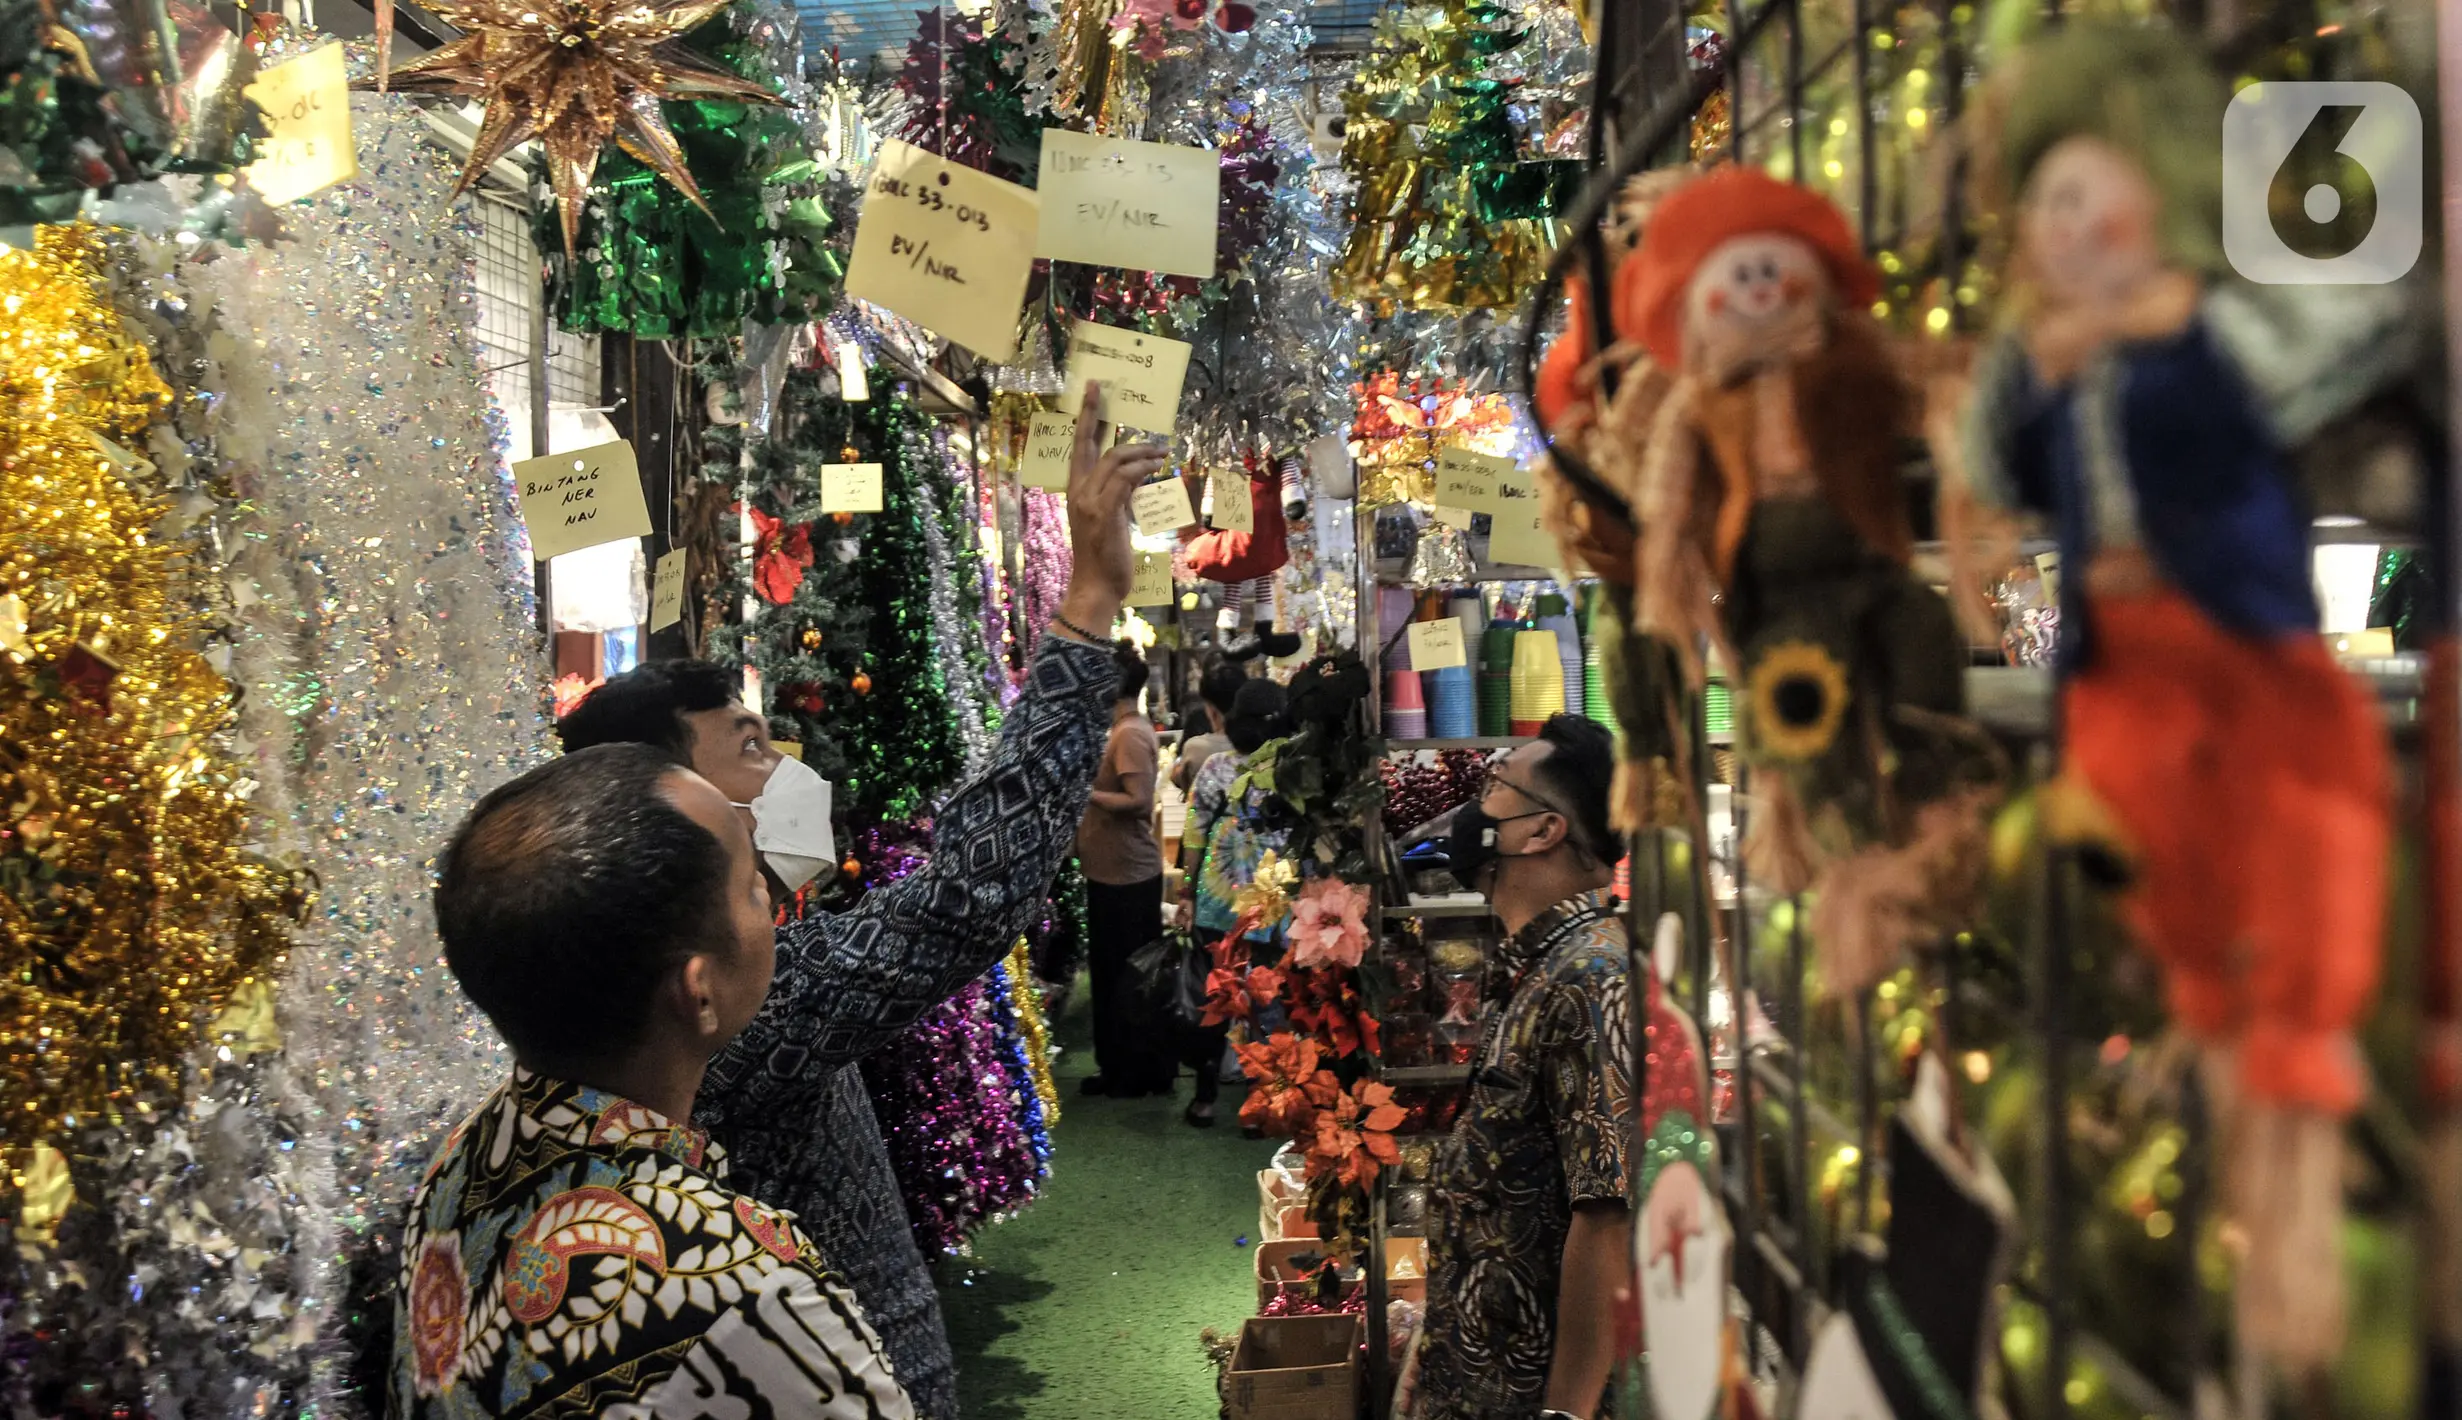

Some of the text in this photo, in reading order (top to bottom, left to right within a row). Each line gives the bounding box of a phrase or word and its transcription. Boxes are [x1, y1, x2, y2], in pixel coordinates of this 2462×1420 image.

[918, 185, 990, 231] 33-013
[526, 467, 600, 497] BINTANG
[562, 487, 595, 506] NER
[564, 508, 598, 526] NAV
